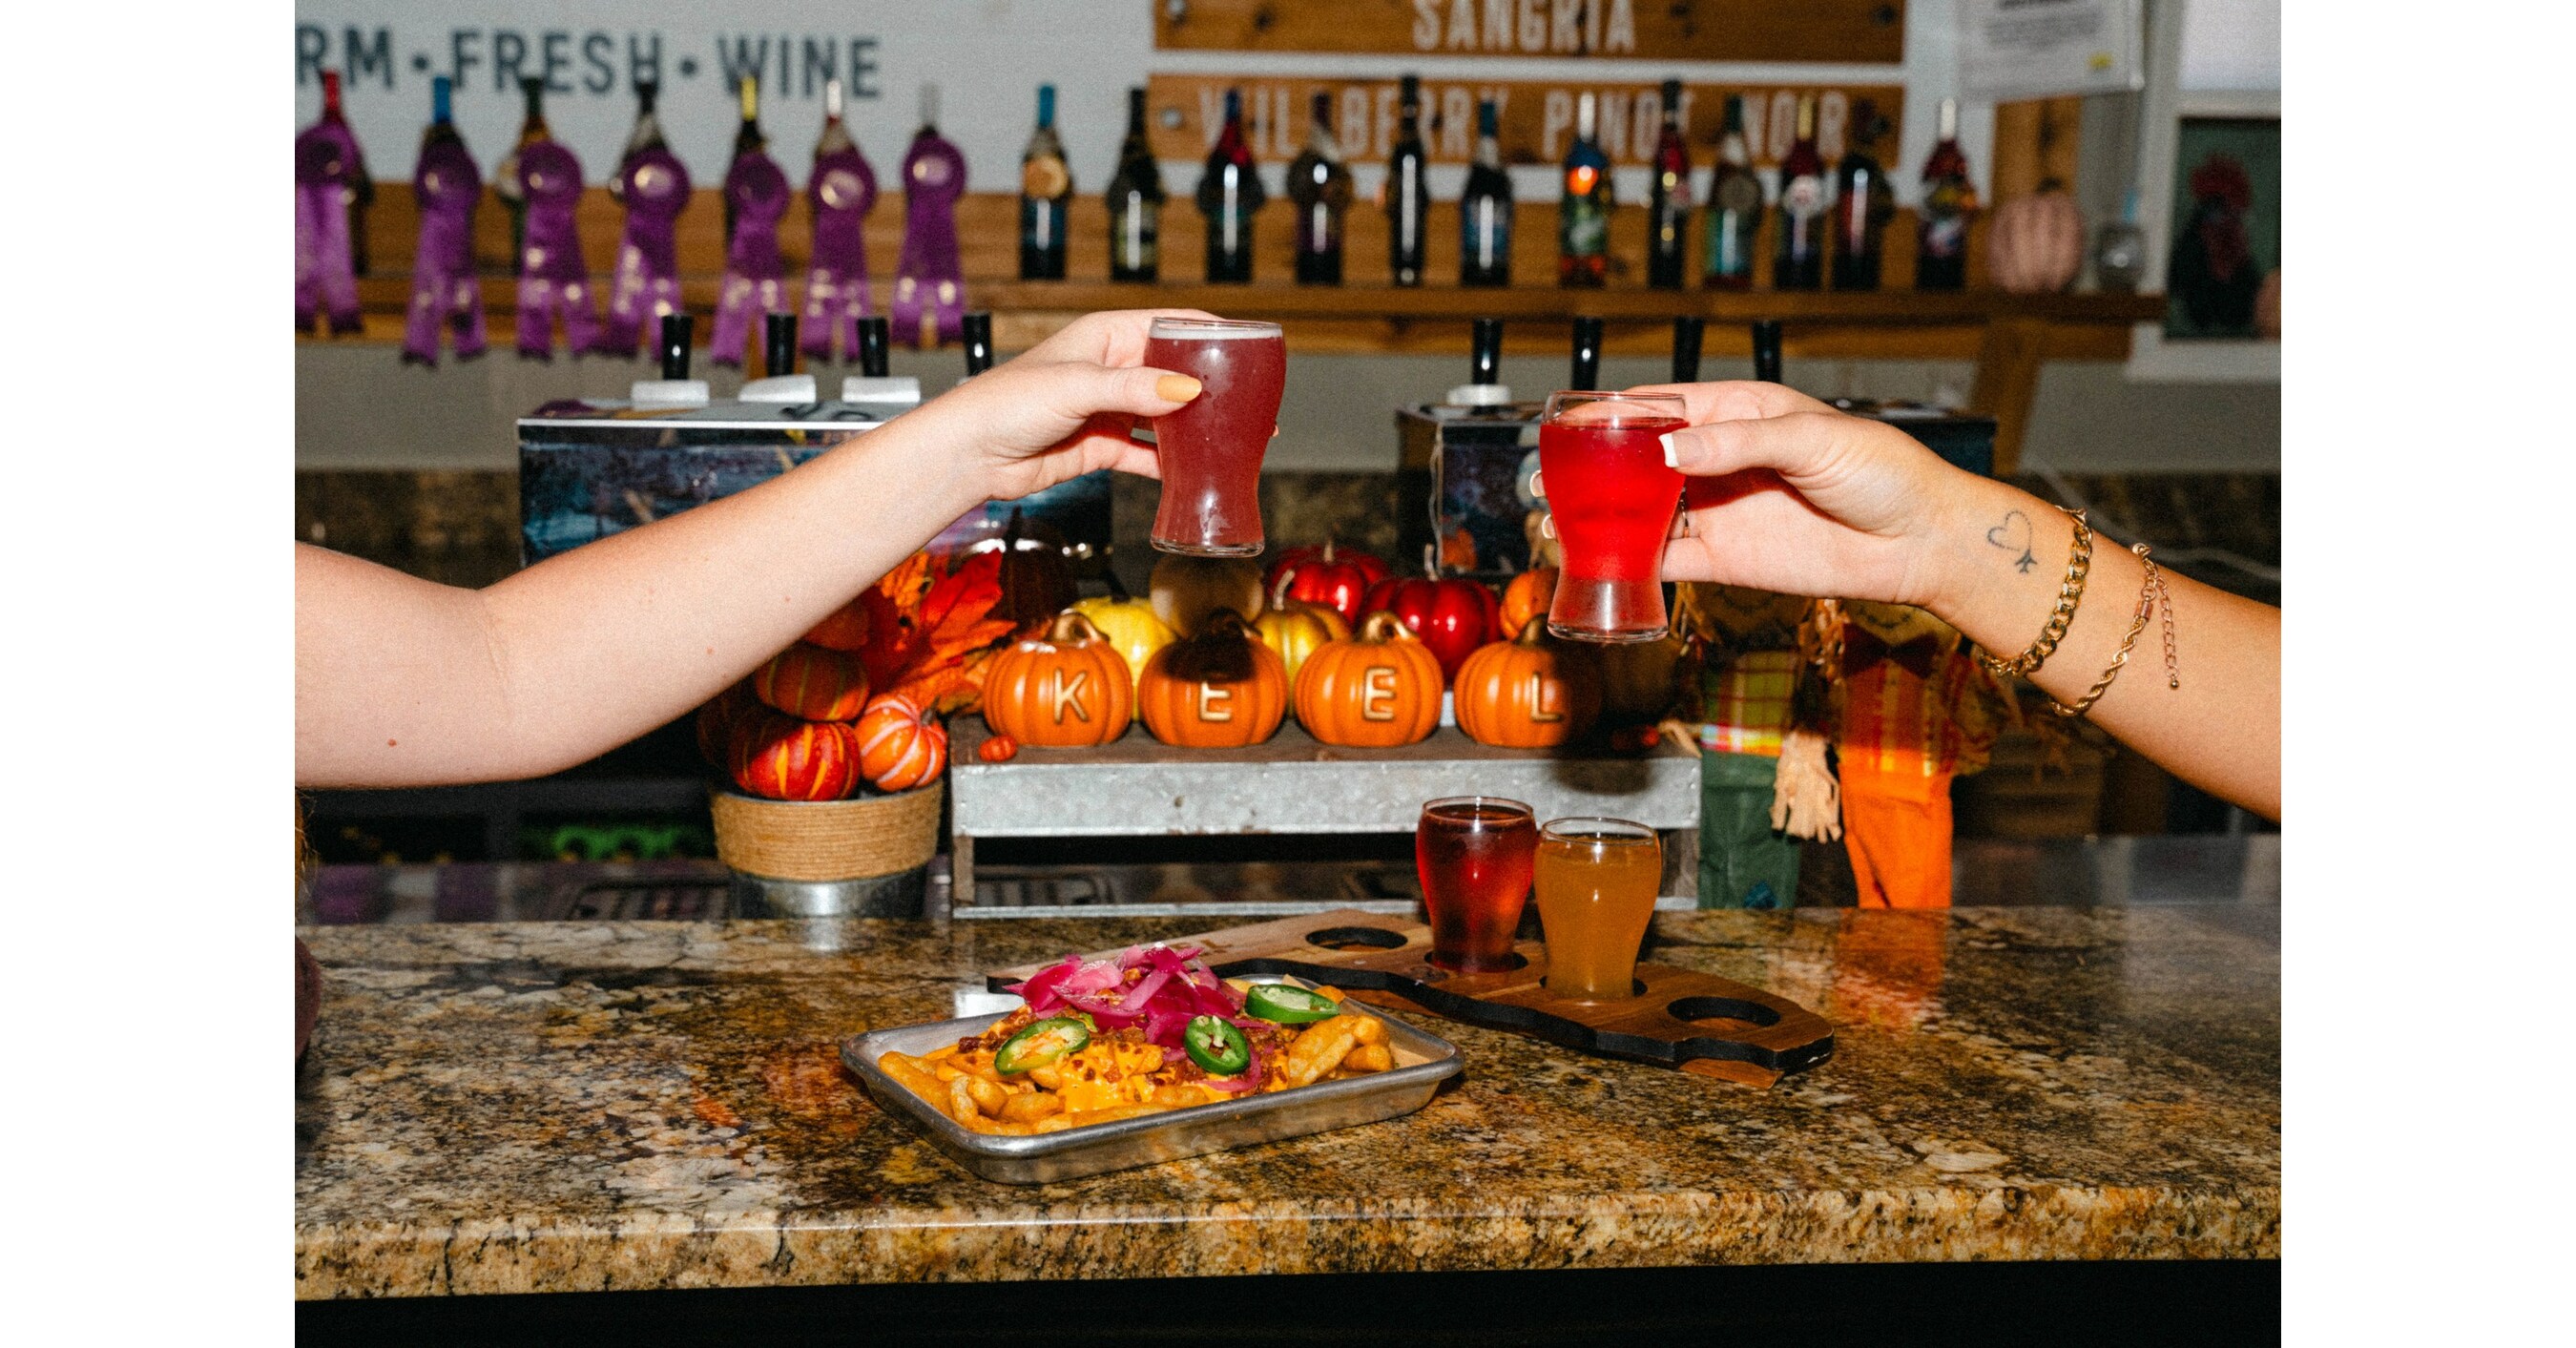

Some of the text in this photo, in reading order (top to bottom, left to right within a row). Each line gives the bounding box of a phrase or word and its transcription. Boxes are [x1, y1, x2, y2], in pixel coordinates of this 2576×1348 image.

[1411, 0, 1635, 51] SANGRIA
[451, 29, 660, 93] FRESH
[717, 33, 879, 98] WINE
[1542, 90, 1694, 159] PNO
[1729, 91, 1849, 160] NOR
[1052, 668, 1090, 724] K
[1362, 668, 1396, 721] E
